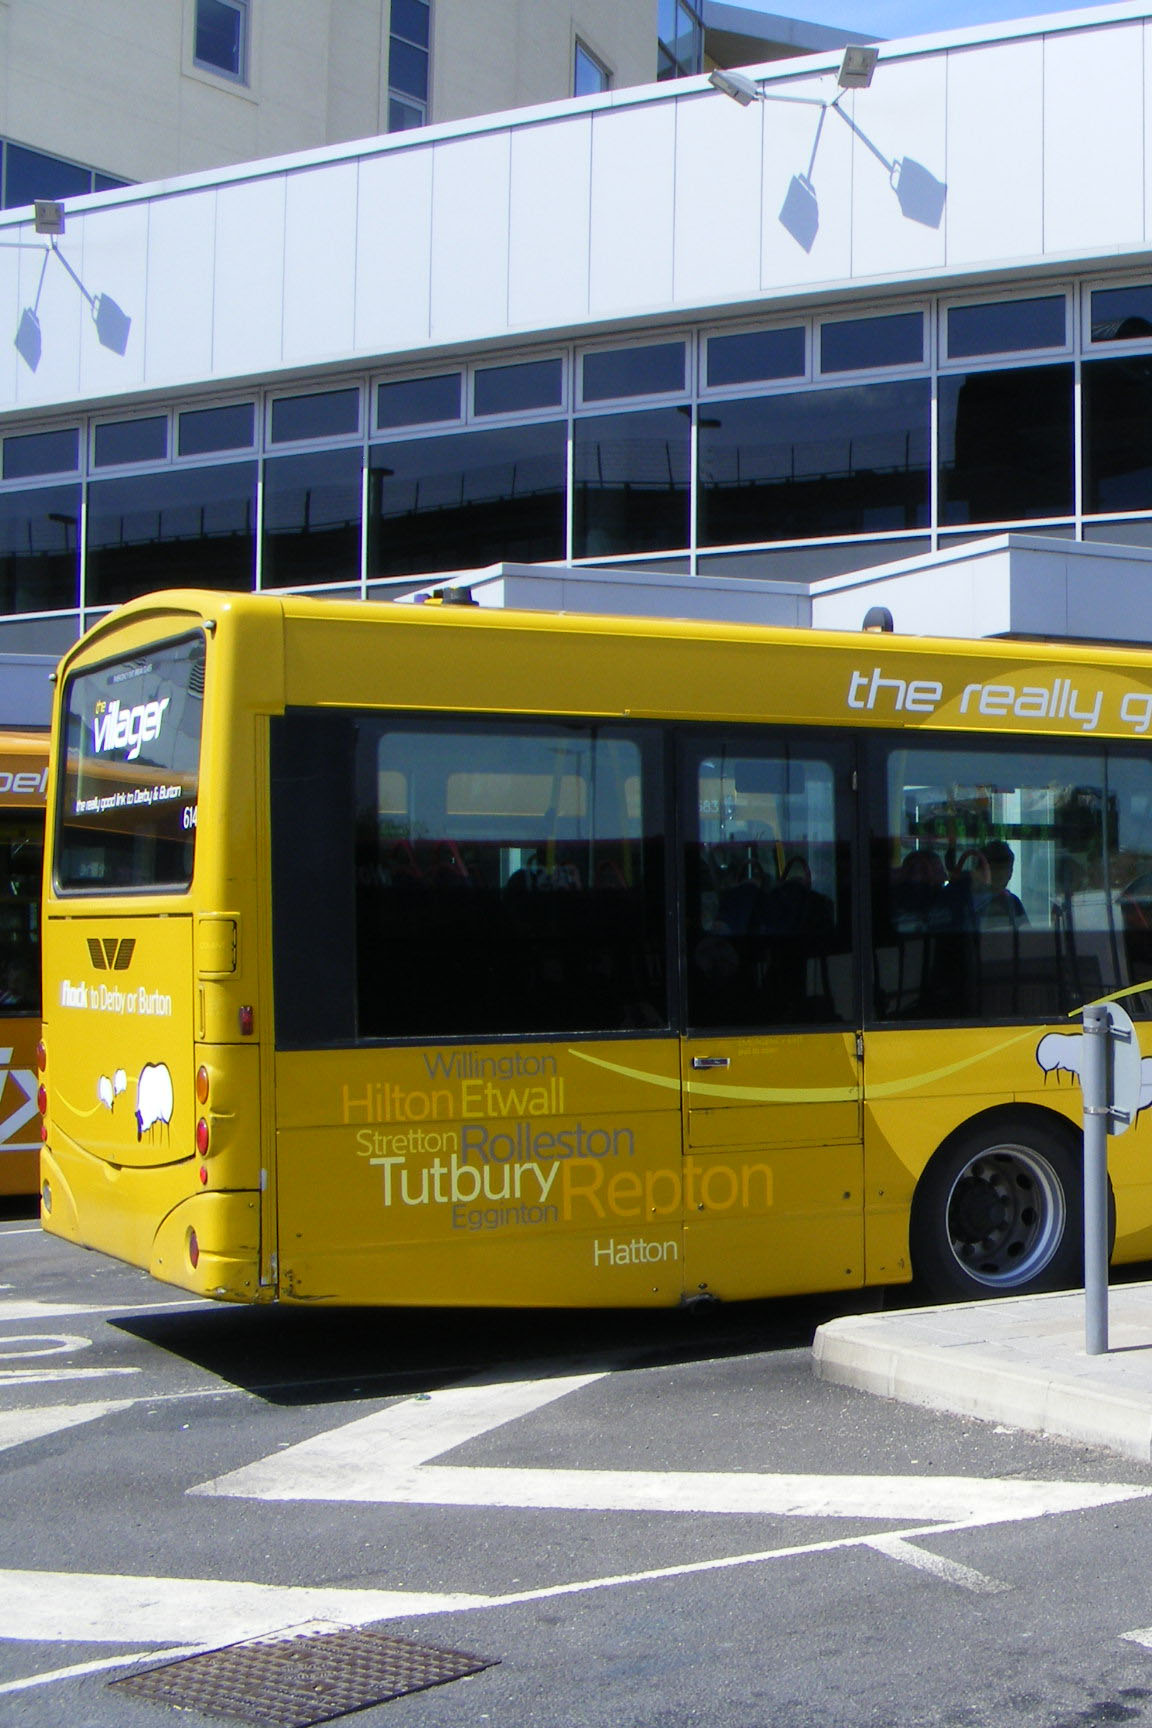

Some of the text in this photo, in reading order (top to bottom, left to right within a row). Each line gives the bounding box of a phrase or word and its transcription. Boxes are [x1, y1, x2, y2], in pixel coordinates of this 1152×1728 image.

[847, 667, 943, 713] the
[959, 677, 1103, 731] really
[94, 697, 170, 761] villager
[134, 788, 153, 805] Derby
[159, 784, 182, 800] Burton
[90, 985, 99, 1009] to
[99, 983, 126, 1015] Derby
[127, 992, 138, 1013] or
[138, 986, 172, 1016] Burton
[422, 1050, 558, 1081] Willington
[342, 1077, 565, 1124] Hilton Etwall
[356, 1122, 635, 1164] Stretton Rolleston
[369, 1154, 774, 1222] Tutbury Repton
[451, 1202, 559, 1231] Egginton
[594, 1238, 678, 1266] Hatton
